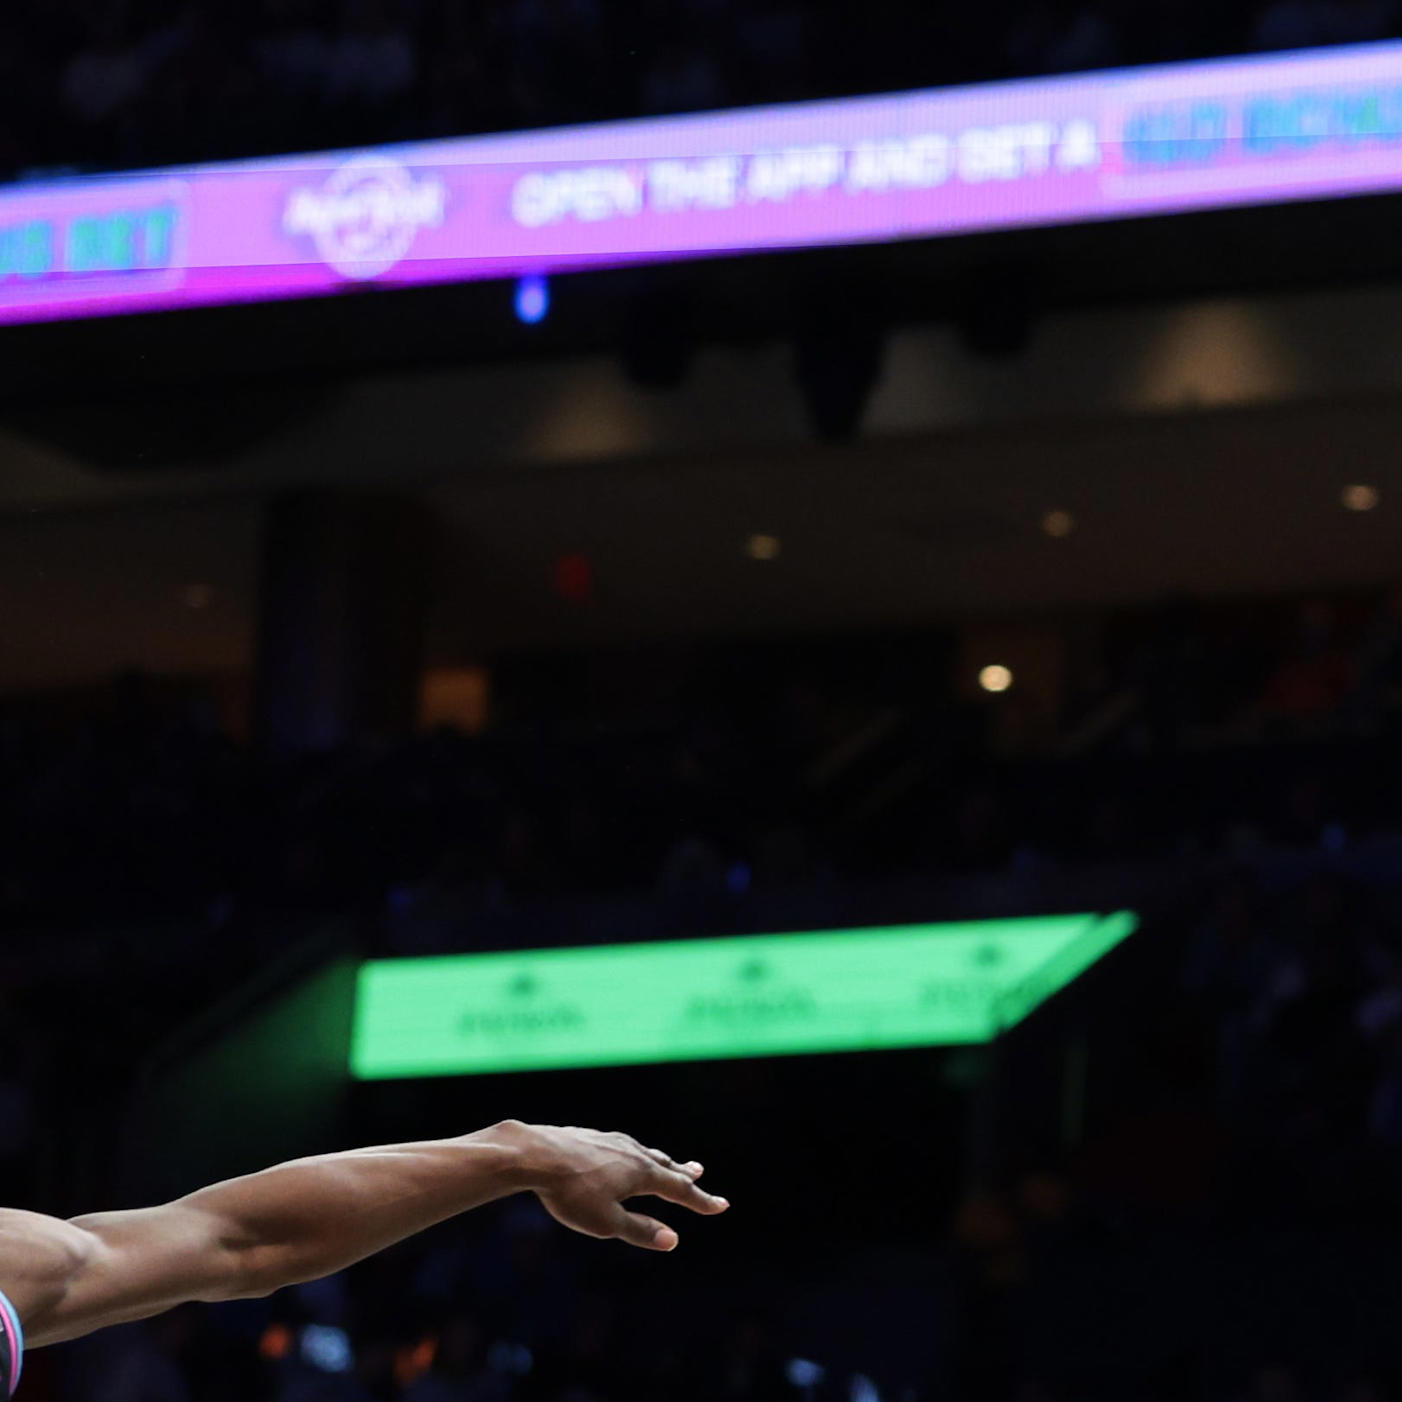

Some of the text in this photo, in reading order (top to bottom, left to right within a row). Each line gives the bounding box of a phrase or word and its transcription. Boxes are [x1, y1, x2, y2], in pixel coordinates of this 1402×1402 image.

[646, 155, 740, 213] THE
[744, 143, 840, 202] APP
[844, 132, 952, 193] AND
